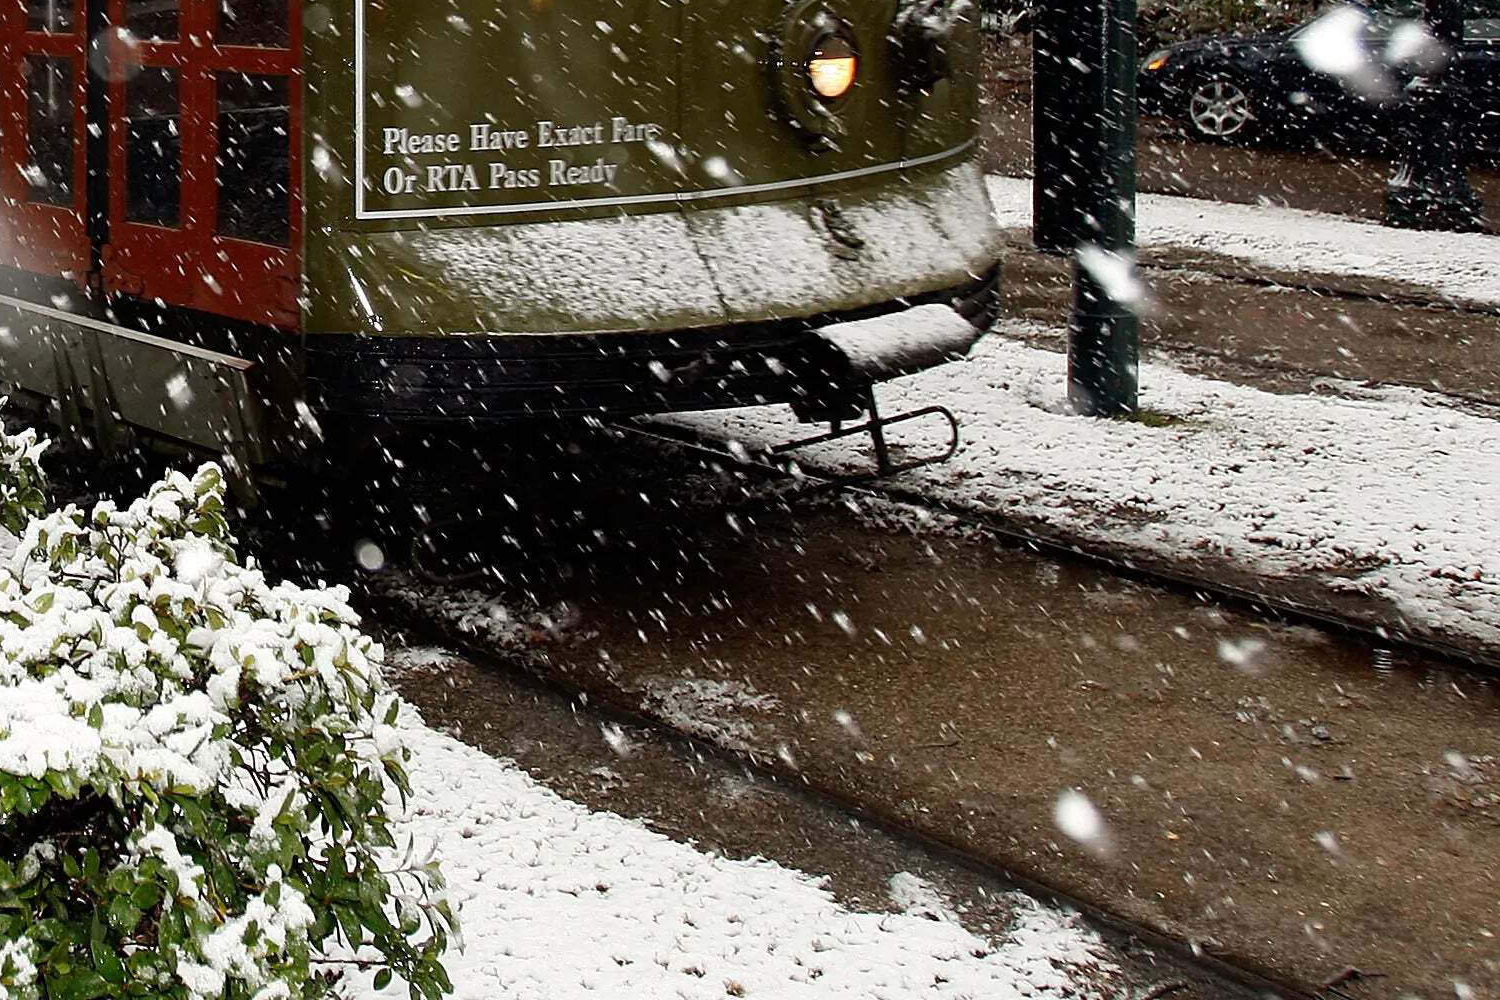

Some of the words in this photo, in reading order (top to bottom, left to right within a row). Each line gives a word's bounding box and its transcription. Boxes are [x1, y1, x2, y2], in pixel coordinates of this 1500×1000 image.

[383, 127, 460, 155] Please
[469, 123, 529, 151] Have
[537, 120, 604, 148] Exact
[611, 116, 658, 143] Fare
[383, 166, 418, 195] Or
[426, 164, 481, 192] RTA
[489, 162, 540, 189] Pass
[548, 157, 618, 187] Ready
